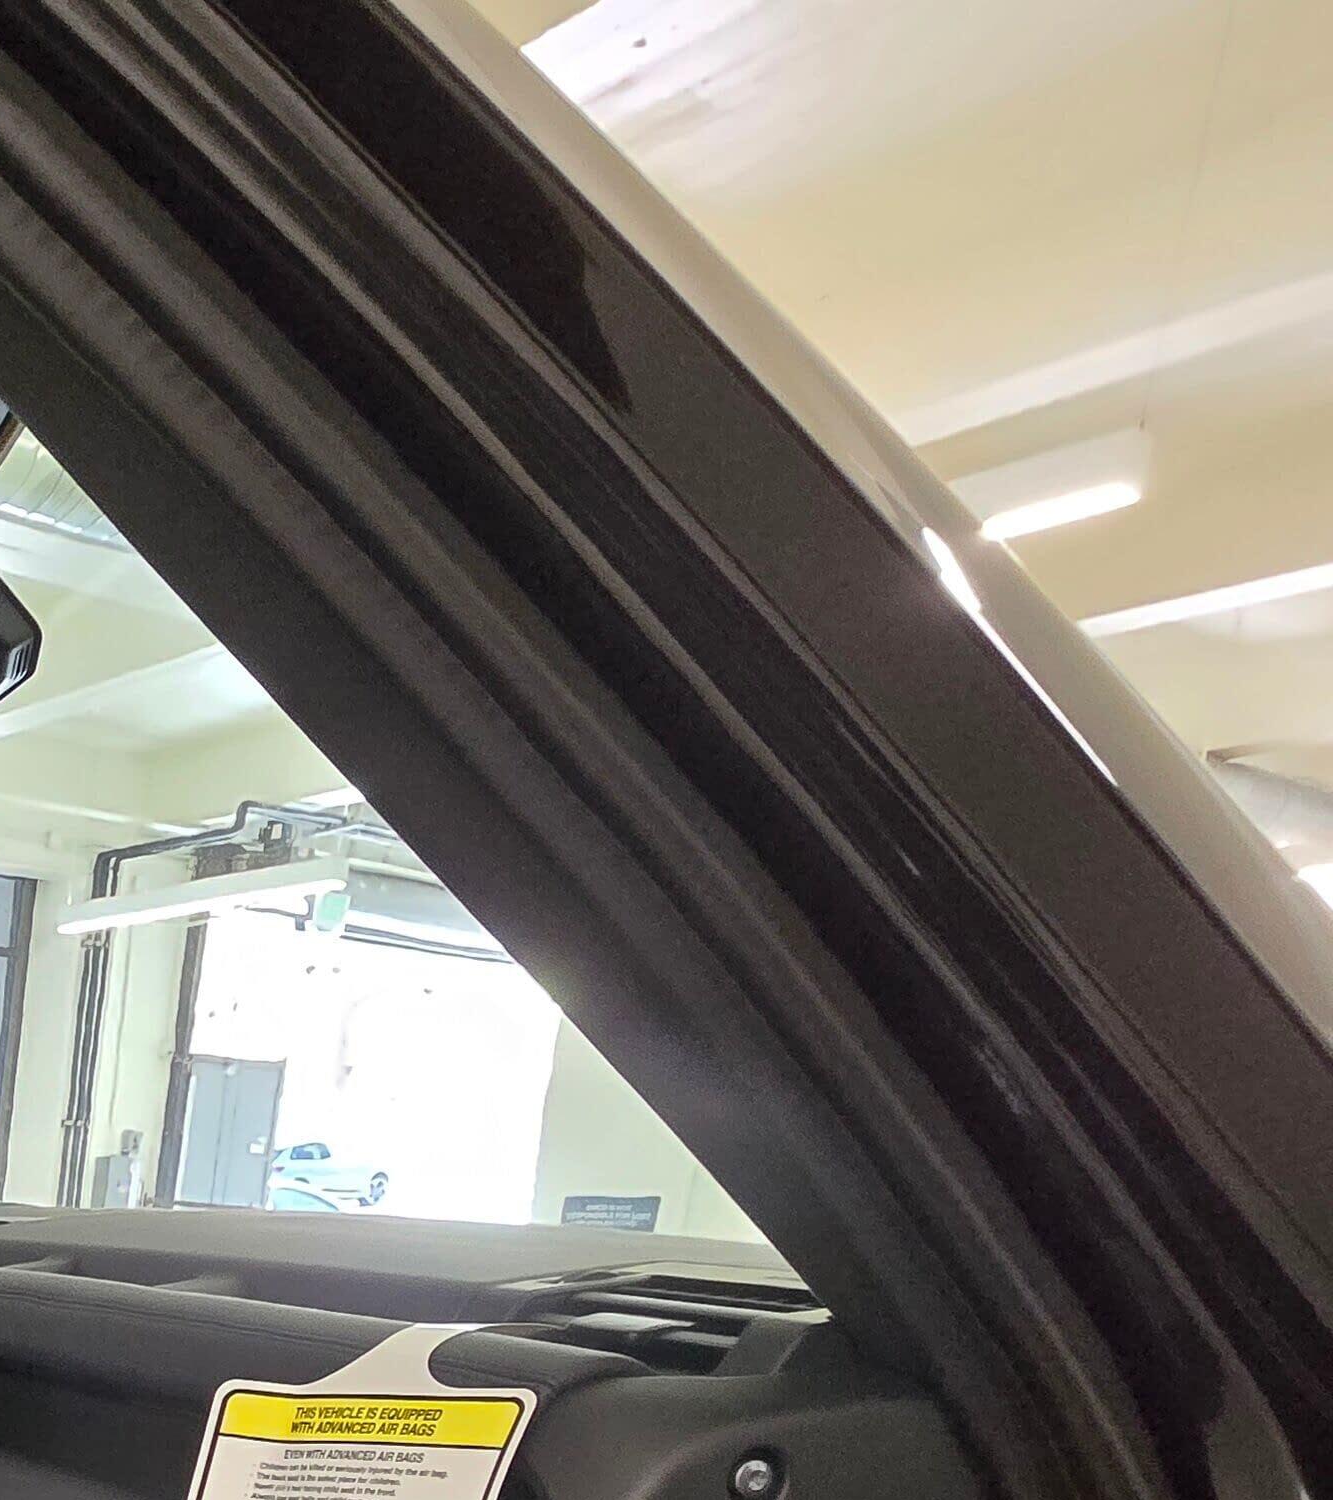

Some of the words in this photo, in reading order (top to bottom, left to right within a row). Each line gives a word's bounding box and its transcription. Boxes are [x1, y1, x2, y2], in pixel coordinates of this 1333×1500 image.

[295, 1407, 316, 1419] THIS
[317, 1407, 365, 1420] VEHICLE
[364, 1408, 378, 1420] IS
[378, 1408, 443, 1421] EQUIPPED
[291, 1422, 315, 1433] WITH
[315, 1422, 376, 1435] ADVANCED
[377, 1423, 399, 1436] AIR
[399, 1424, 437, 1436] BAGS
[326, 1450, 377, 1461] ADVANCED
[377, 1451, 395, 1461] AIR
[395, 1452, 425, 1463] BAGS
